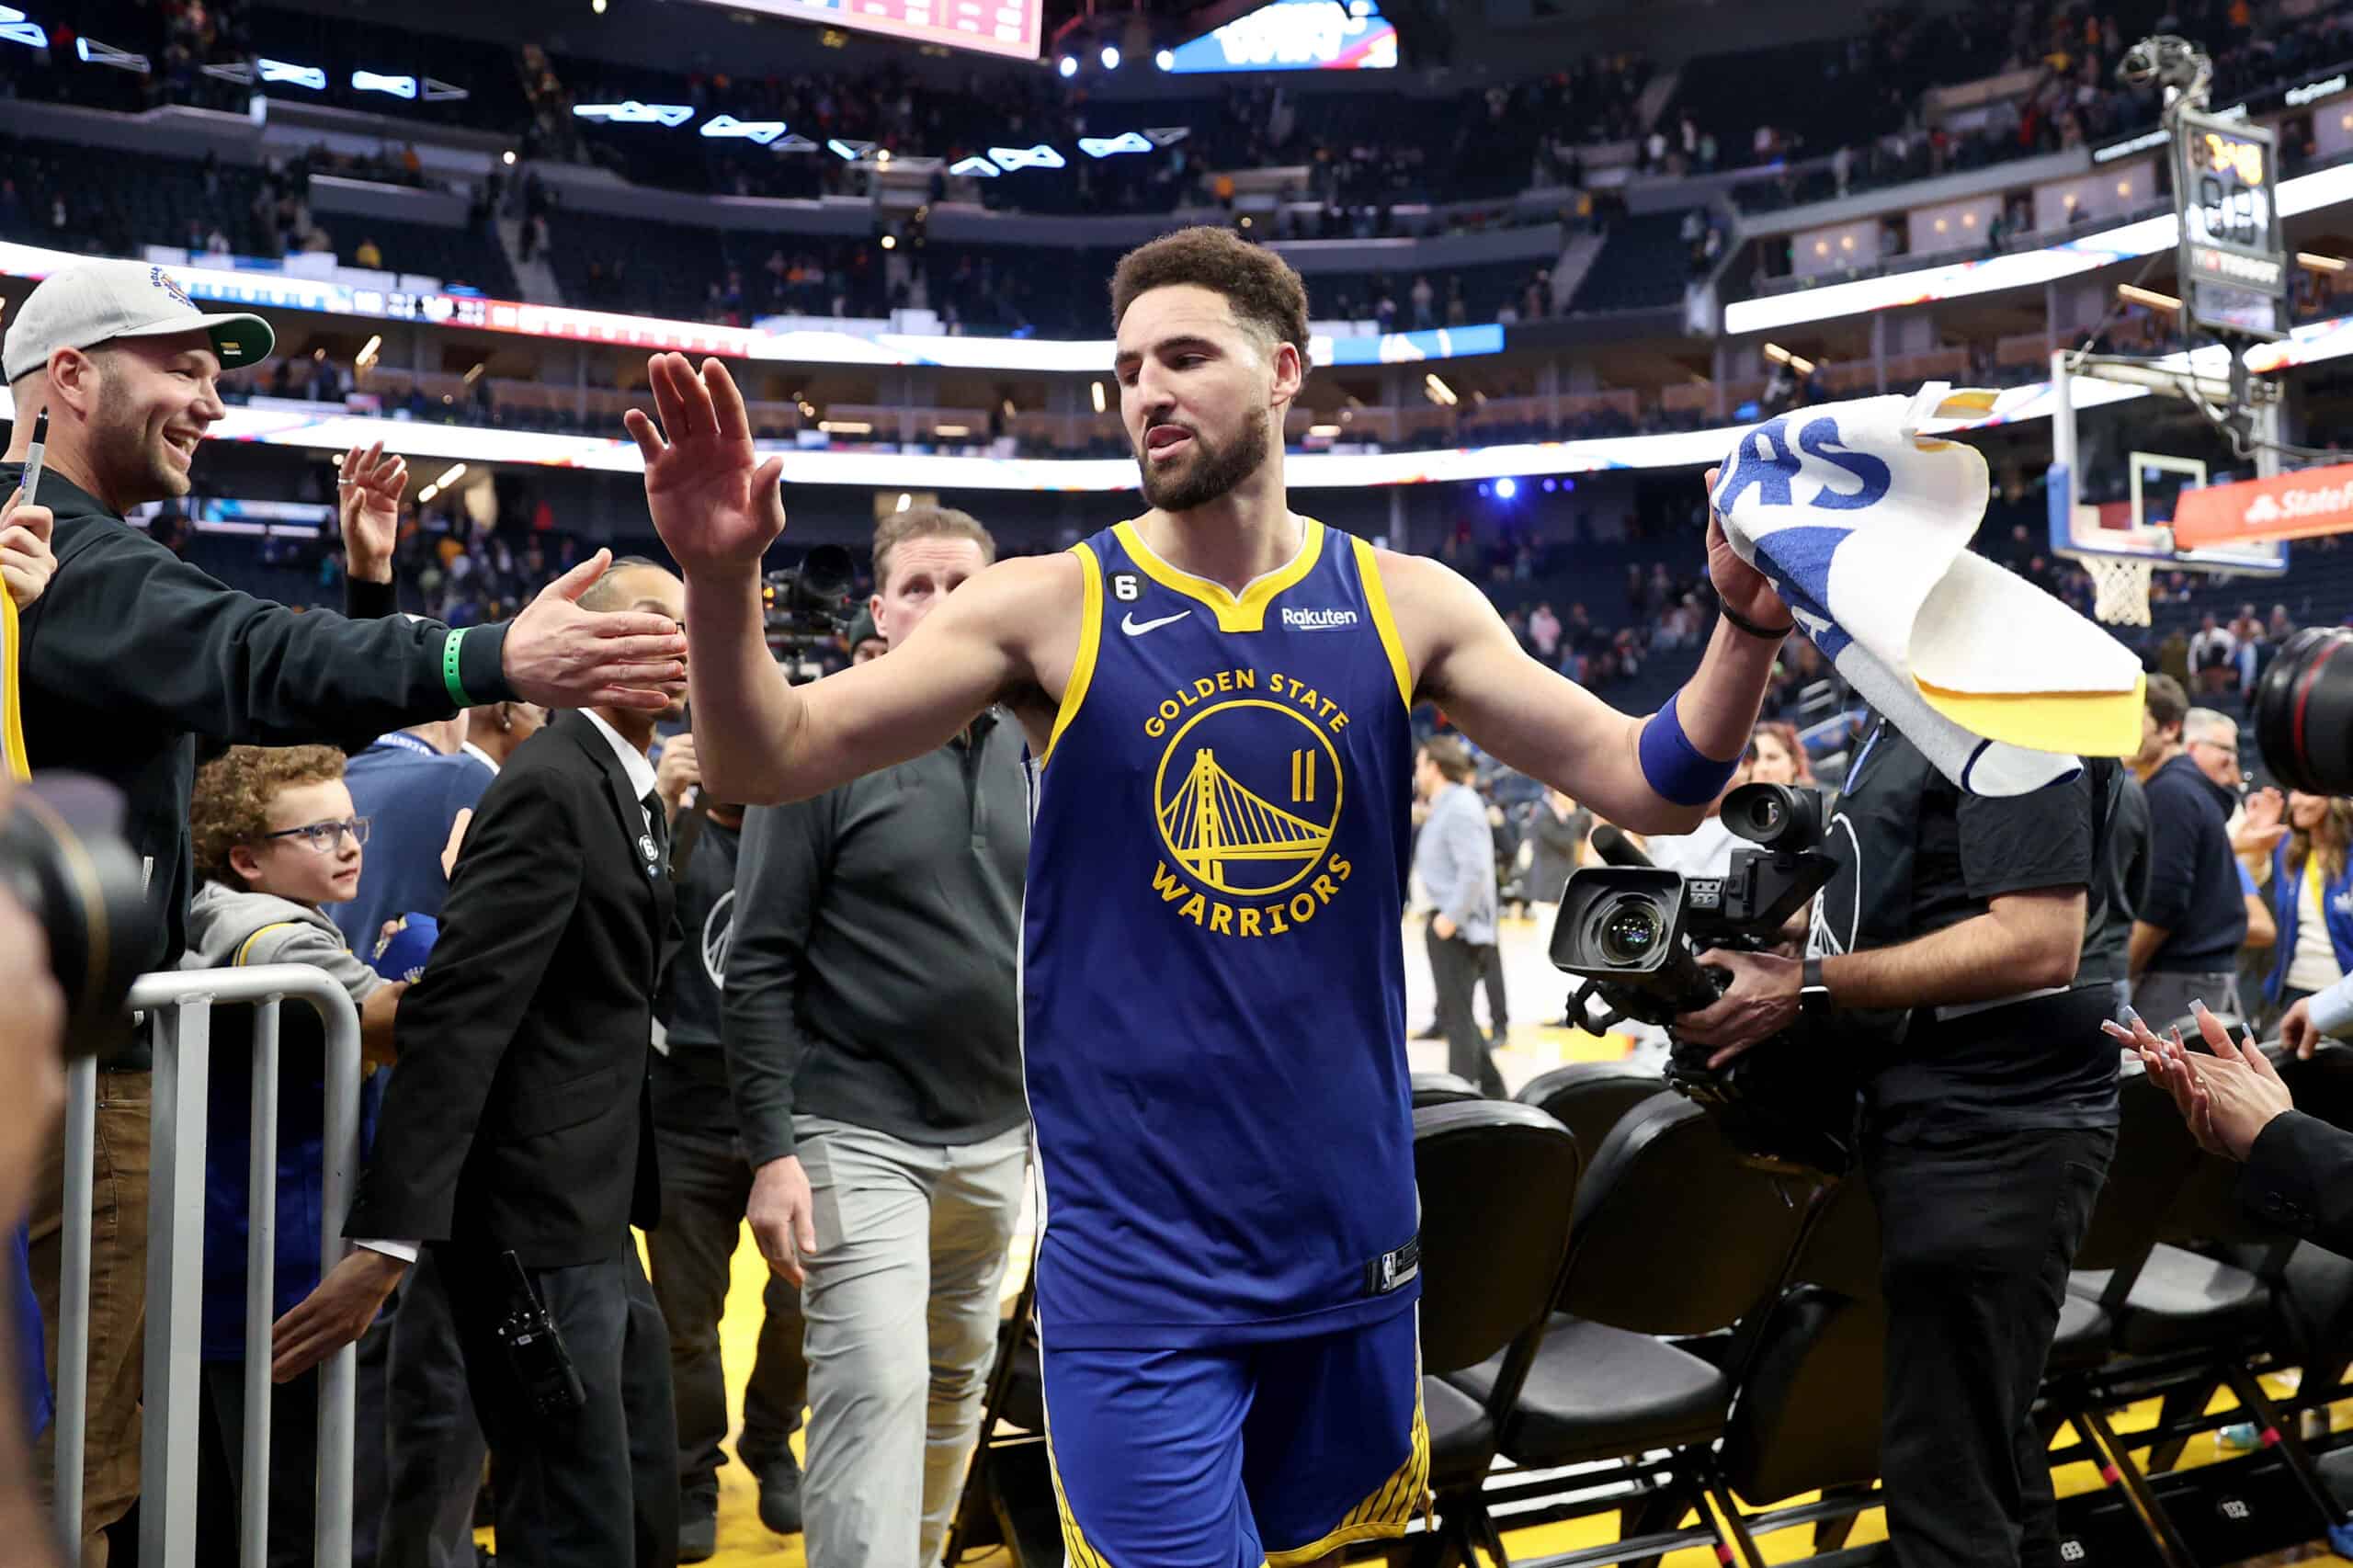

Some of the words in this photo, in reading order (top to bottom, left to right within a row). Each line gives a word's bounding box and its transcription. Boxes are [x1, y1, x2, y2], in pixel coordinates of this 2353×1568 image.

[1114, 574, 1138, 600] 6
[1281, 607, 1358, 626] Rakuten
[1144, 668, 1256, 737] GOLDEN
[1269, 673, 1349, 734] STATE
[1291, 749, 1315, 802] 11
[643, 837, 655, 857] 6
[1151, 852, 1352, 937] WARRIORS
